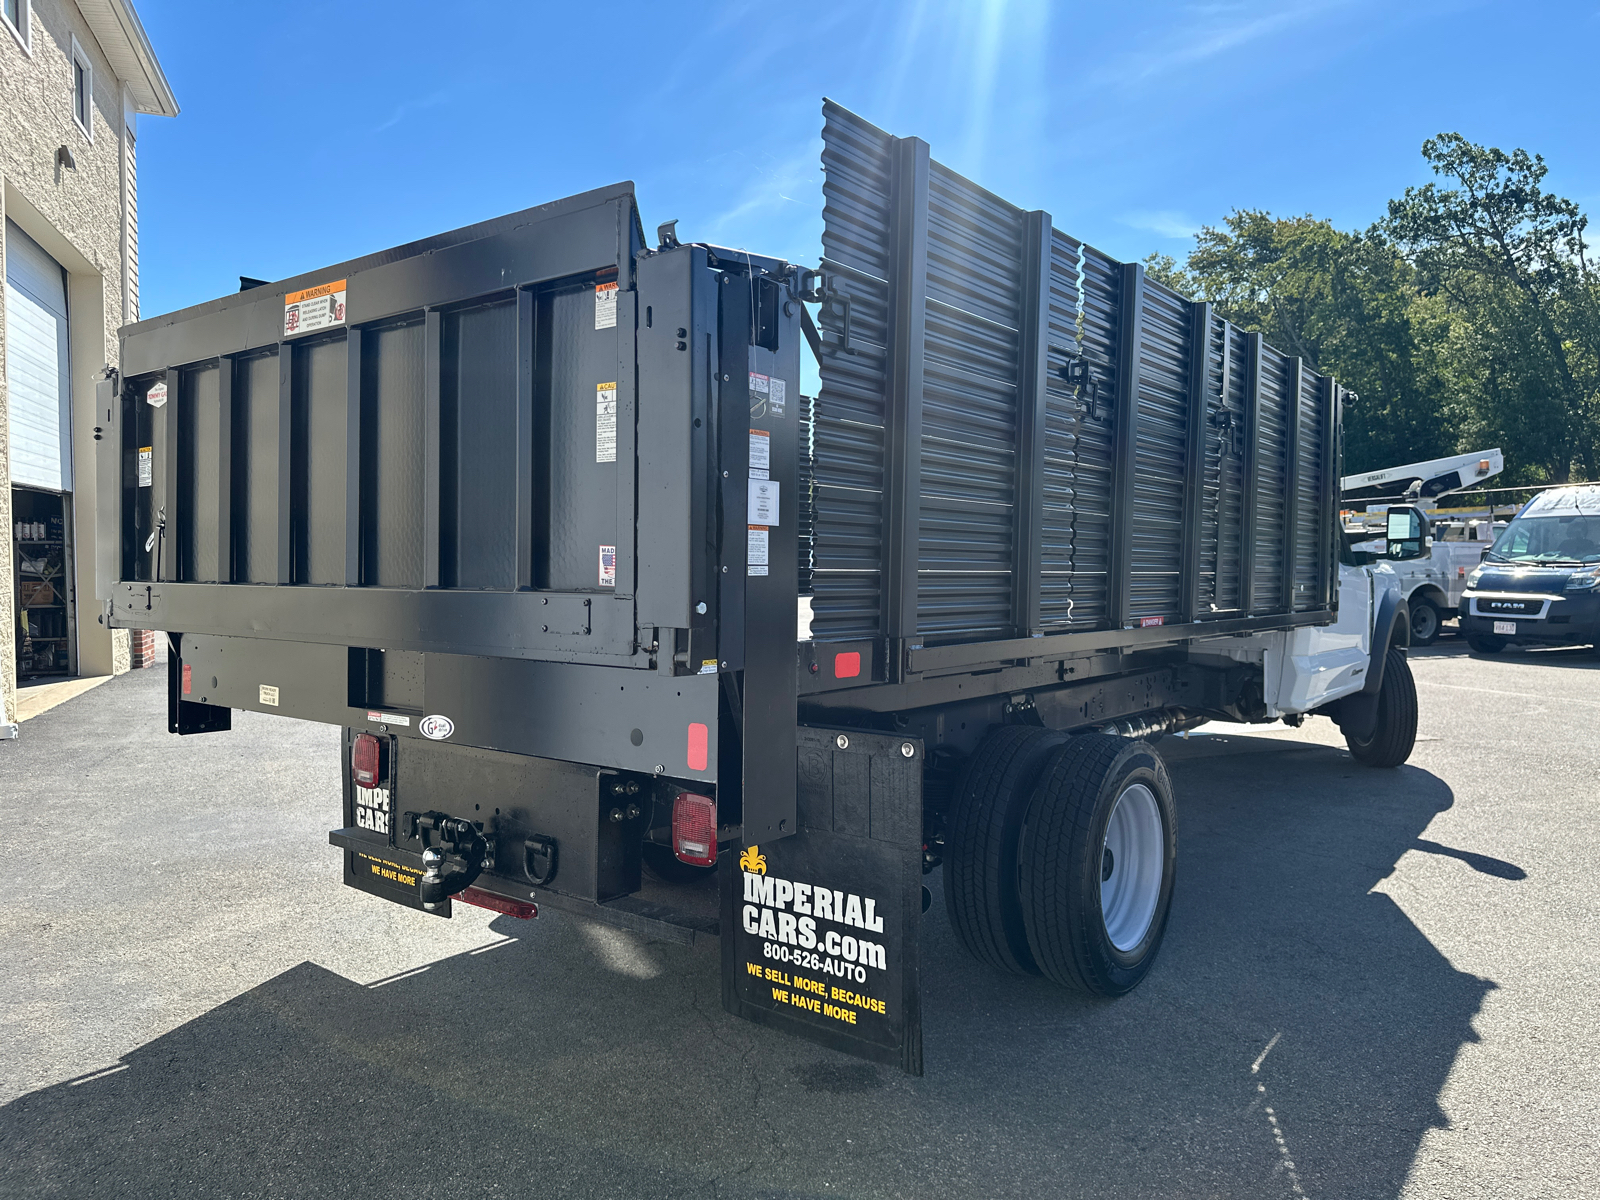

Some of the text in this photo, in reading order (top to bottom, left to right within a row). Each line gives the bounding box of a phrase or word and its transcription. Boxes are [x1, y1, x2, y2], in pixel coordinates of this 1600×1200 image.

[306, 286, 330, 298] WARNING
[603, 282, 618, 290] WAR
[1367, 473, 1386, 482] VERSALIFT
[1146, 617, 1159, 626] DANGER
[372, 864, 416, 886] WE HAVE MORE
[743, 872, 884, 934] IMPERIAL
[742, 904, 887, 970] CARS.com
[763, 942, 866, 983] 800-526-AUTO
[746, 962, 886, 1014] WE SELL MORE, BECAUSE
[772, 988, 857, 1025] WE HAVE MORE
